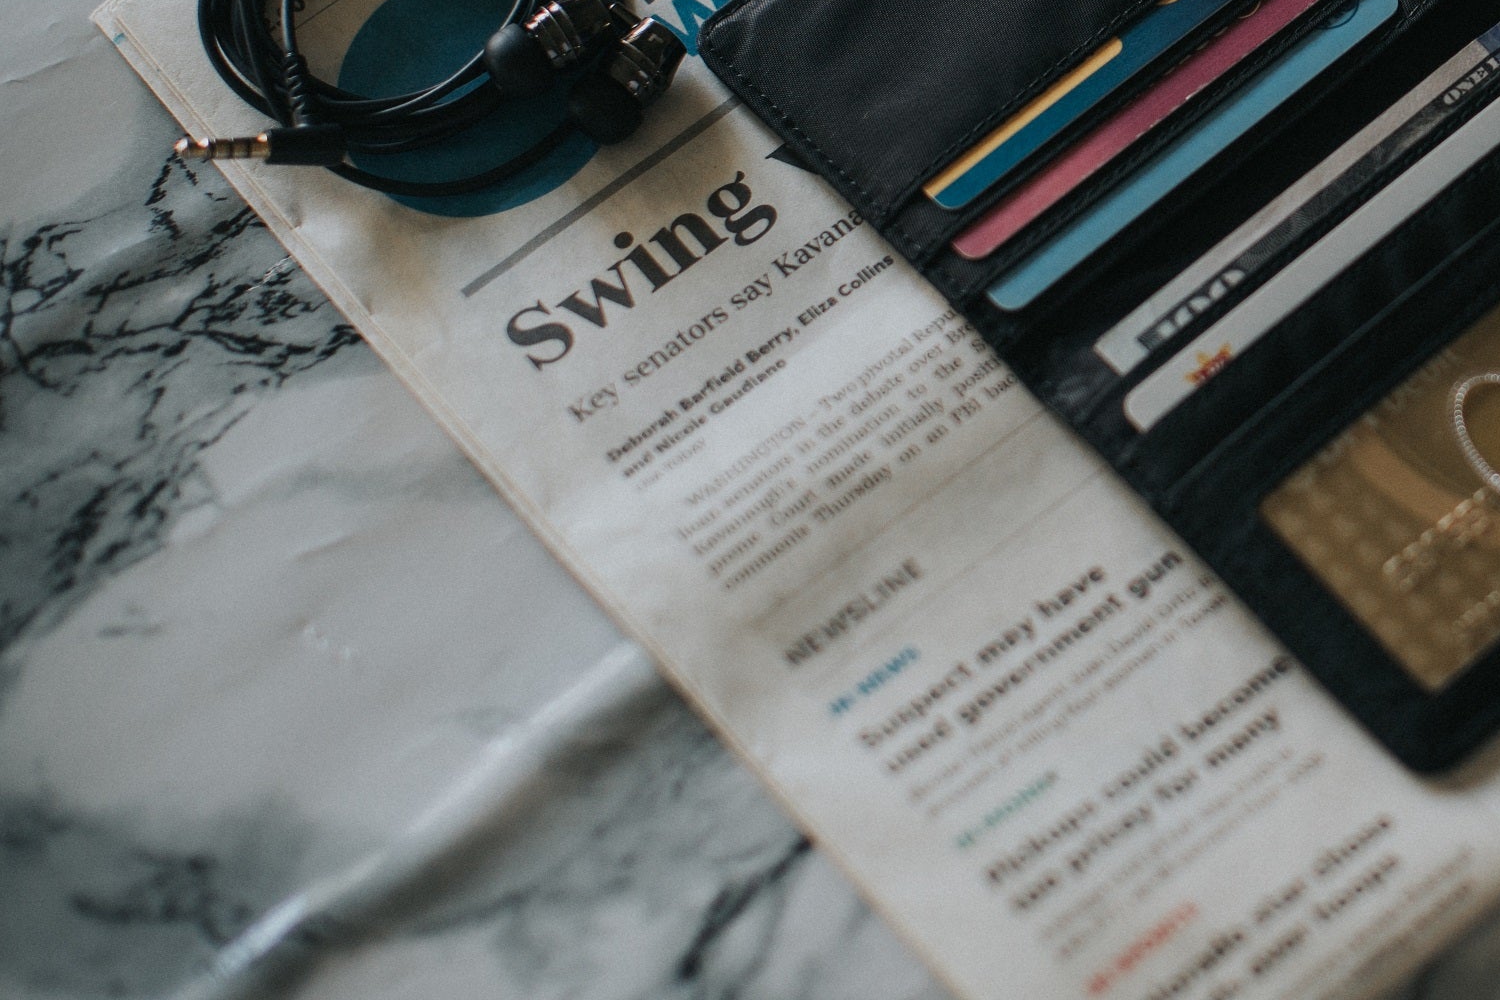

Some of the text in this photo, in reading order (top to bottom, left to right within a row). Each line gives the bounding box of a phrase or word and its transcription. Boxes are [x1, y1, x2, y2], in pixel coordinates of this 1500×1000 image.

[1443, 66, 1489, 106] ONE
[506, 170, 777, 371] Swing
[566, 204, 868, 426] Key senators say Kavana
[606, 250, 897, 464] Deborah Barfield Berry, Eliza Collins
[621, 357, 787, 478] and Nicole Gaudiano
[805, 402, 901, 476] nomination
[906, 382, 928, 400] to
[933, 355, 963, 381] the
[817, 415, 845, 438] the
[849, 372, 905, 418] debate
[908, 343, 945, 374] over
[818, 380, 858, 411] Two
[855, 337, 915, 389] pivotal
[769, 488, 818, 527] Court
[823, 449, 873, 491] made
[879, 396, 945, 449] initially
[813, 464, 892, 524] Thursday
[898, 445, 919, 464] on
[926, 424, 947, 445] an
[785, 557, 925, 667] NEWSLINE
[859, 565, 1105, 750] Suspect may have
[957, 591, 1125, 726] government
[1126, 546, 1187, 601] gun
[1184, 652, 1295, 741] become
[1204, 709, 1279, 770] many
